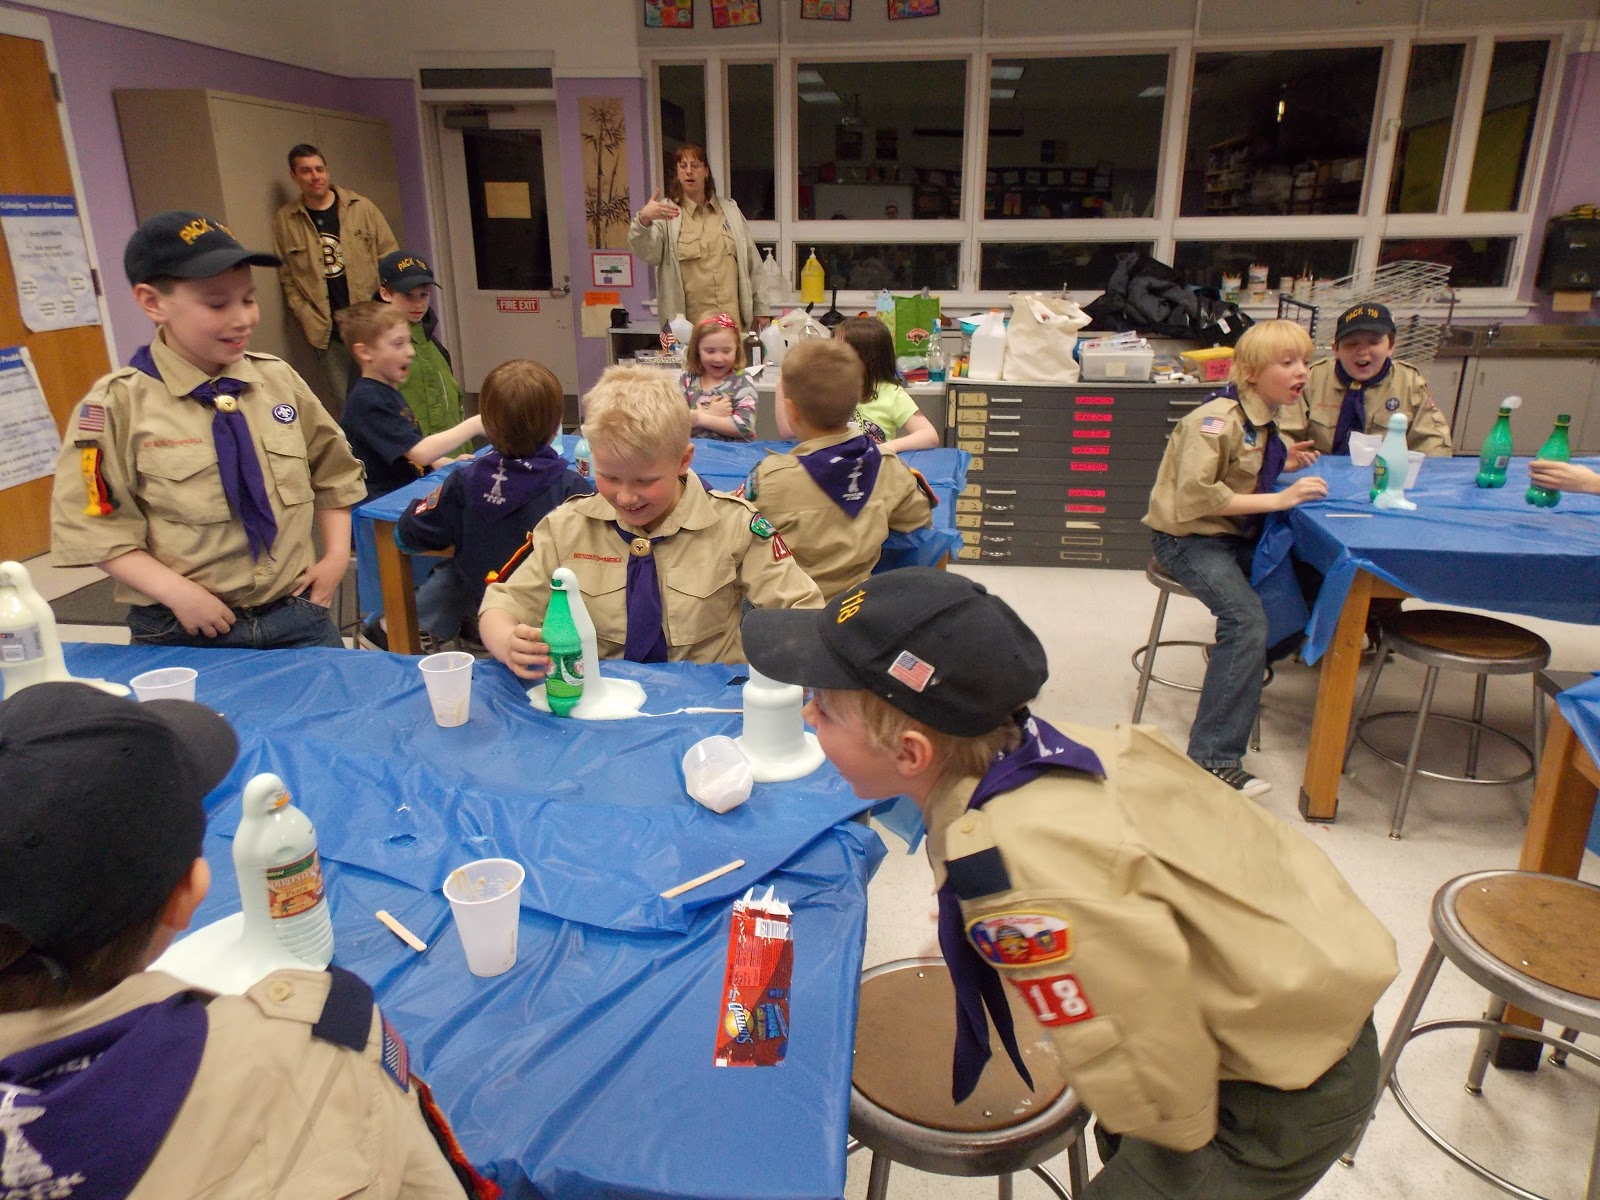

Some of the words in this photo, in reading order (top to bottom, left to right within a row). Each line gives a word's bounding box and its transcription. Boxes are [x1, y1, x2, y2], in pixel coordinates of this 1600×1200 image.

[179, 217, 215, 246] PACK
[500, 300, 518, 310] FIRE
[519, 300, 537, 310] EXIT
[836, 589, 867, 624] 118
[1029, 978, 1089, 1022] 18
[728, 1001, 753, 1044] SunnyD
